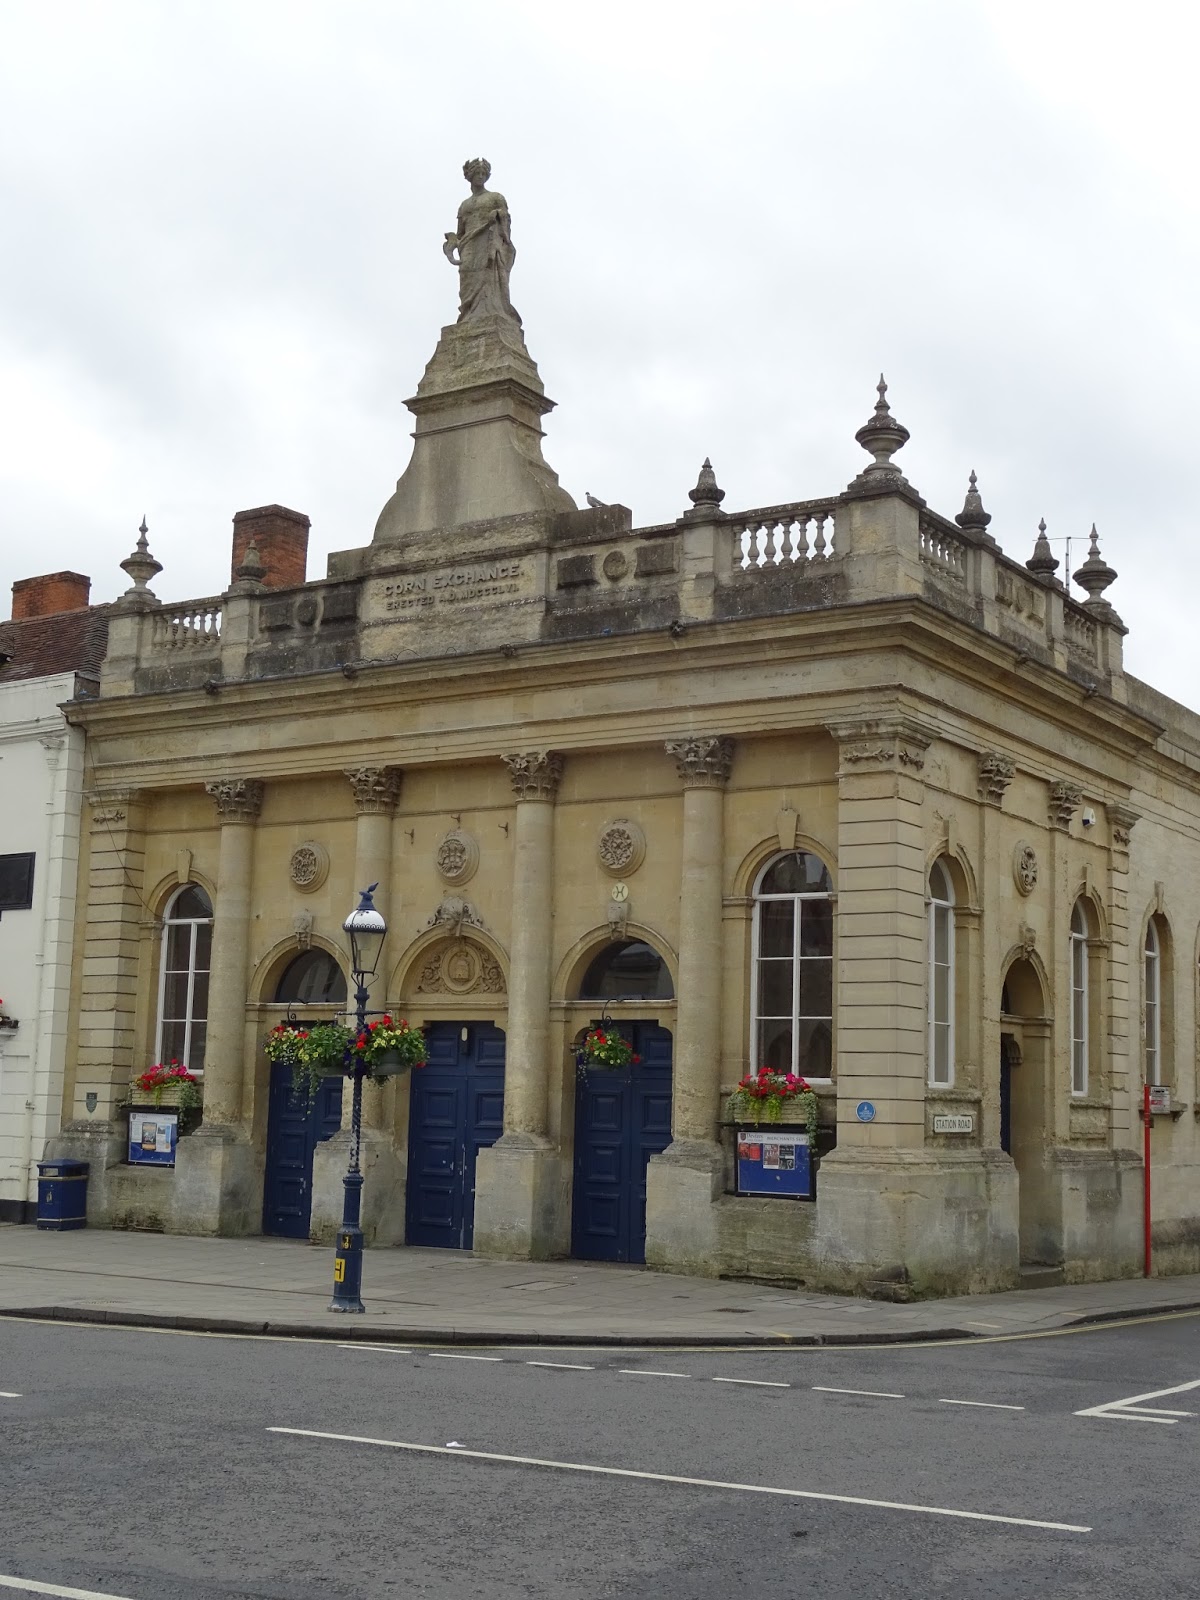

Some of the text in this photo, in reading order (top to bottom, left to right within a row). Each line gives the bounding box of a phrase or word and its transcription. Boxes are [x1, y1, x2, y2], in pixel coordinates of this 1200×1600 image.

[385, 564, 524, 596] CORN EXCHANGE.
[386, 595, 435, 610] ERECTED
[935, 1119, 971, 1129] STATION ROAD
